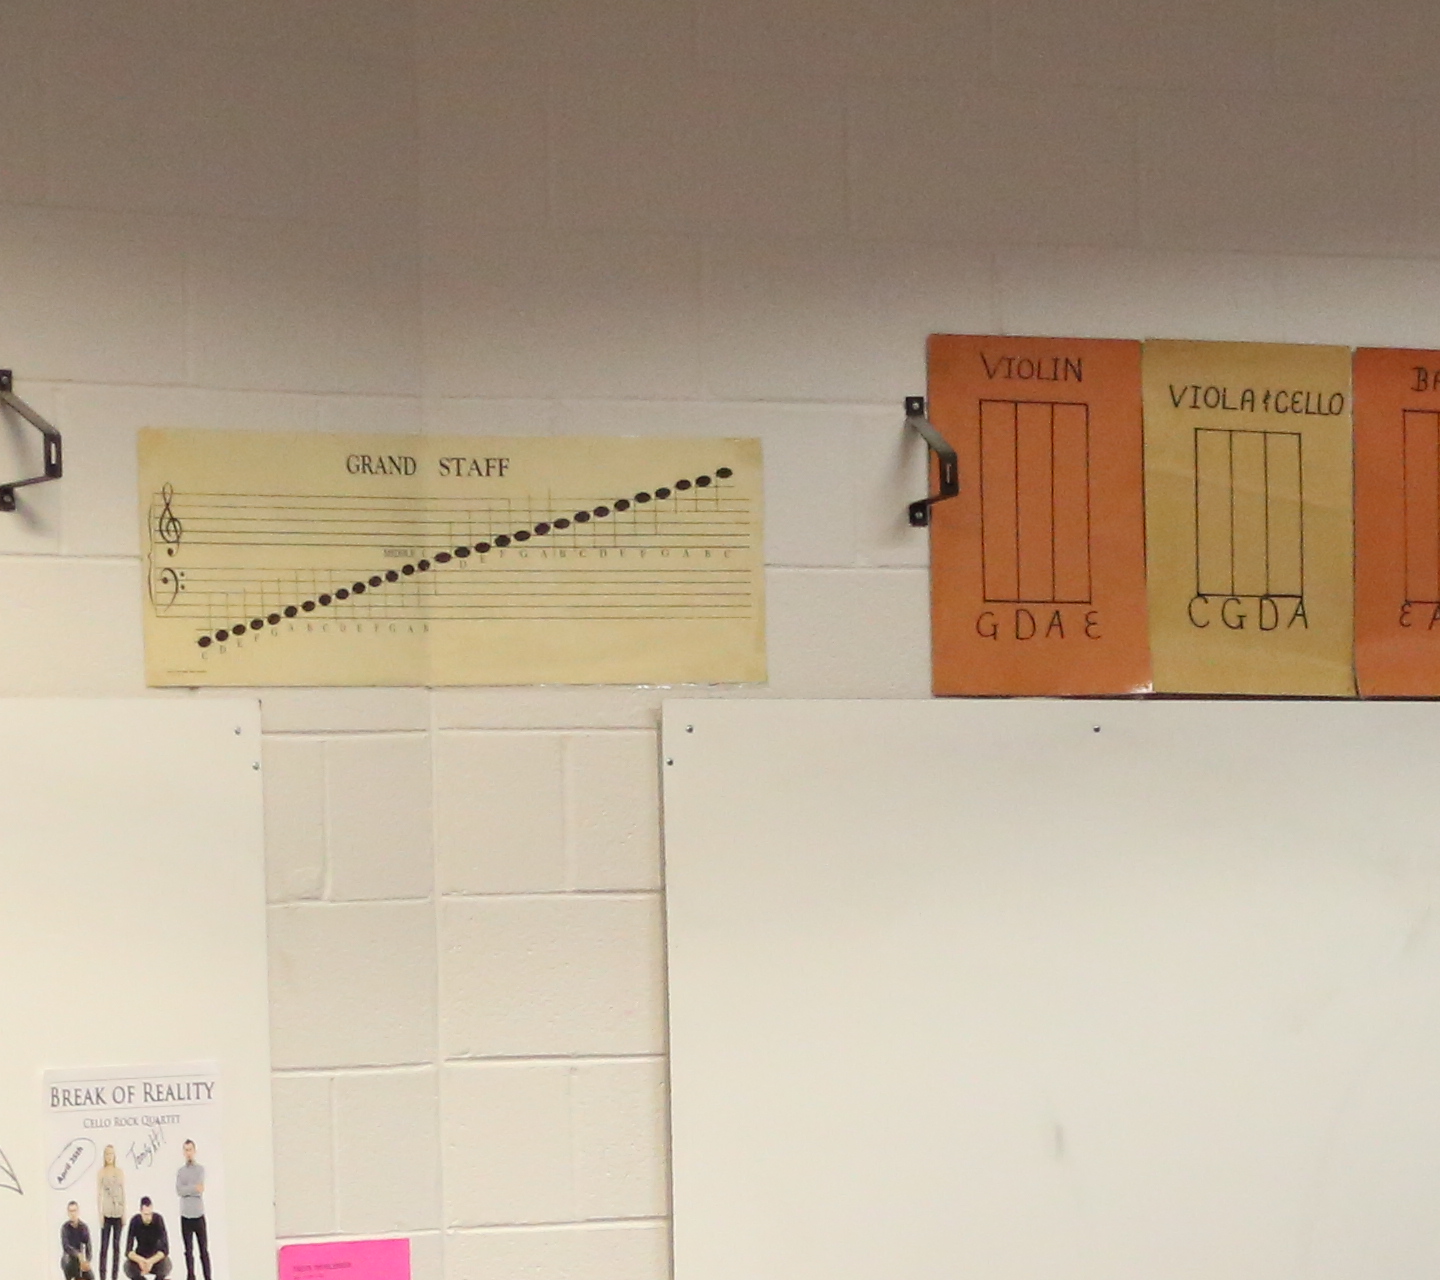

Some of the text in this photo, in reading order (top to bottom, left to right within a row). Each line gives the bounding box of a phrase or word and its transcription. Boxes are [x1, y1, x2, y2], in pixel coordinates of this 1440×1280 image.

[980, 354, 1084, 383] VIOLIN
[1169, 385, 1256, 412] VIOLA
[1274, 390, 1344, 417] CELLO
[346, 454, 509, 477] GRAND STAFF
